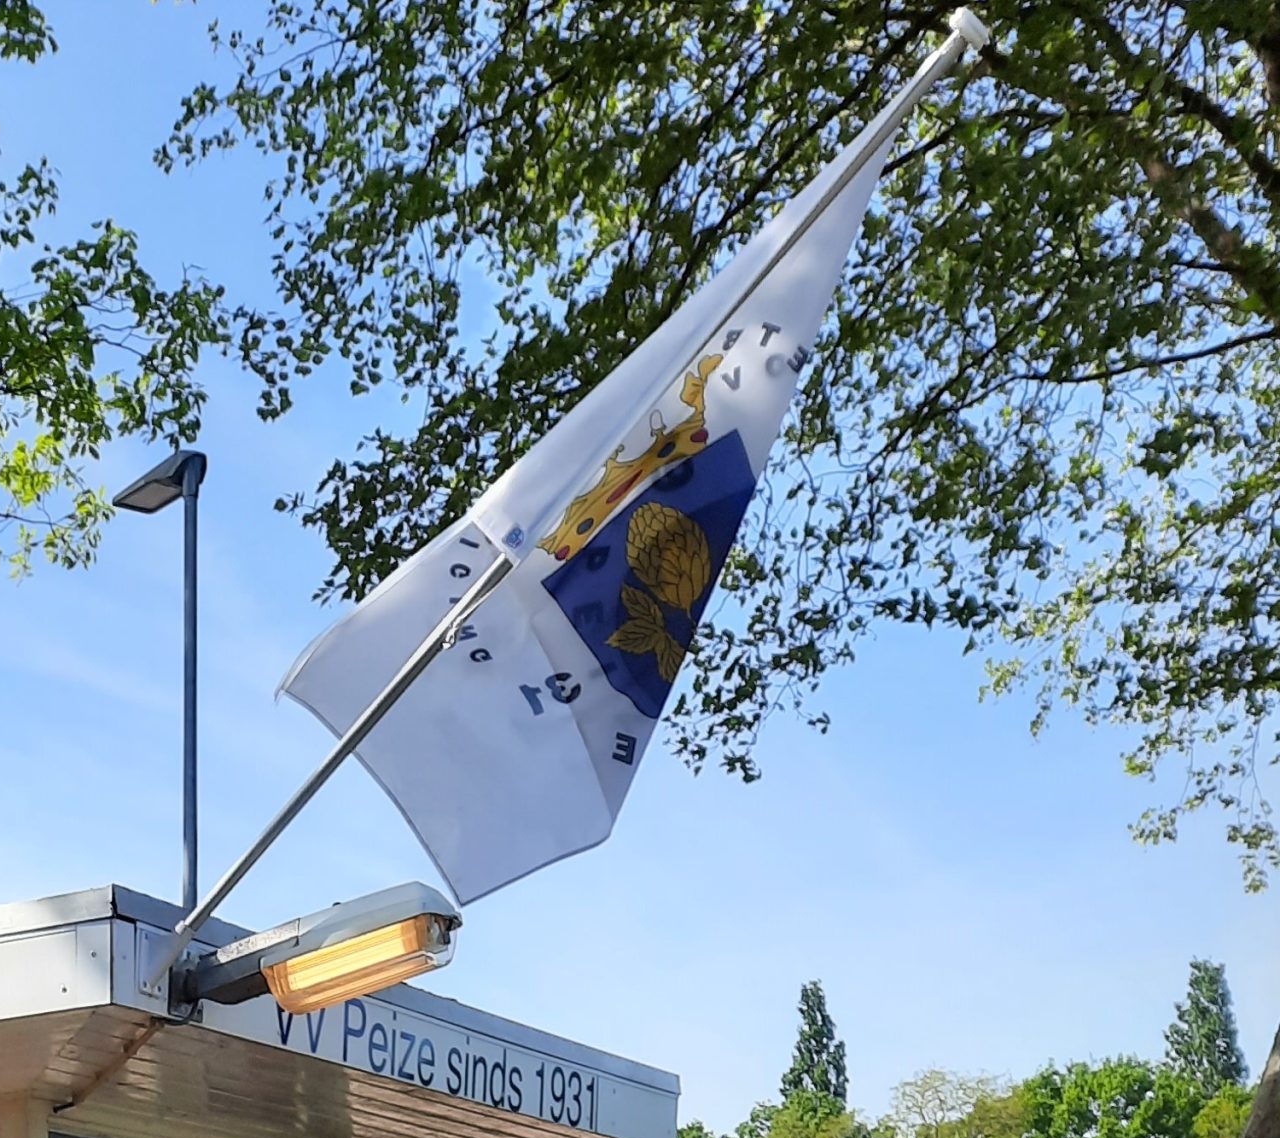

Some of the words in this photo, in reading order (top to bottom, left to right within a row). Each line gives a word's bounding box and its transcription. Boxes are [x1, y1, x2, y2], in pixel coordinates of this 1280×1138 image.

[342, 998, 435, 1087] Peize
[446, 1034, 523, 1113] sinds
[535, 1061, 596, 1131] 1931
